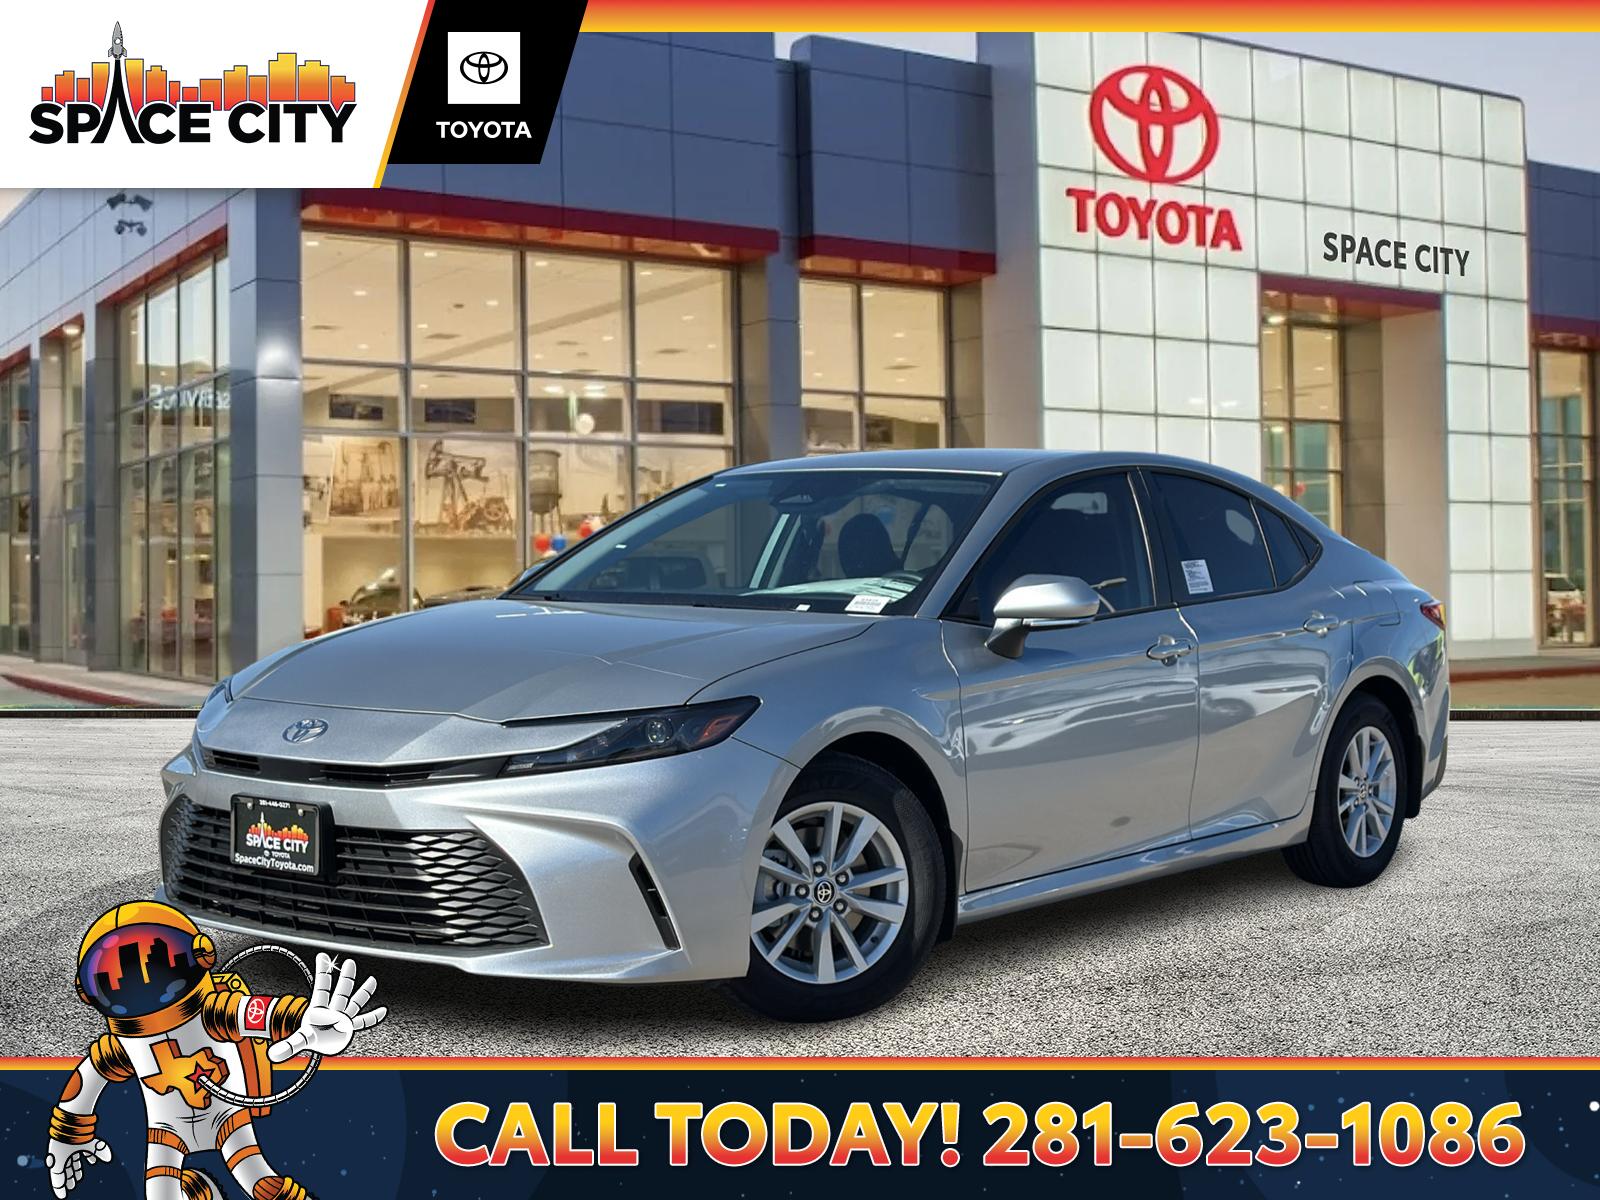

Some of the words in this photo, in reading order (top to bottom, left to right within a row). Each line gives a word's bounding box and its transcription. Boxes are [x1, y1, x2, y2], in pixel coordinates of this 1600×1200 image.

[1065, 187, 1243, 252] TOYOTA
[1322, 231, 1408, 270] SPACE
[1413, 243, 1471, 277] CITY
[246, 832, 281, 850] SPACE
[283, 838, 308, 853] CITY
[235, 853, 314, 872] SpaceCityToyota.com
[271, 851, 290, 859] TOYOTA
